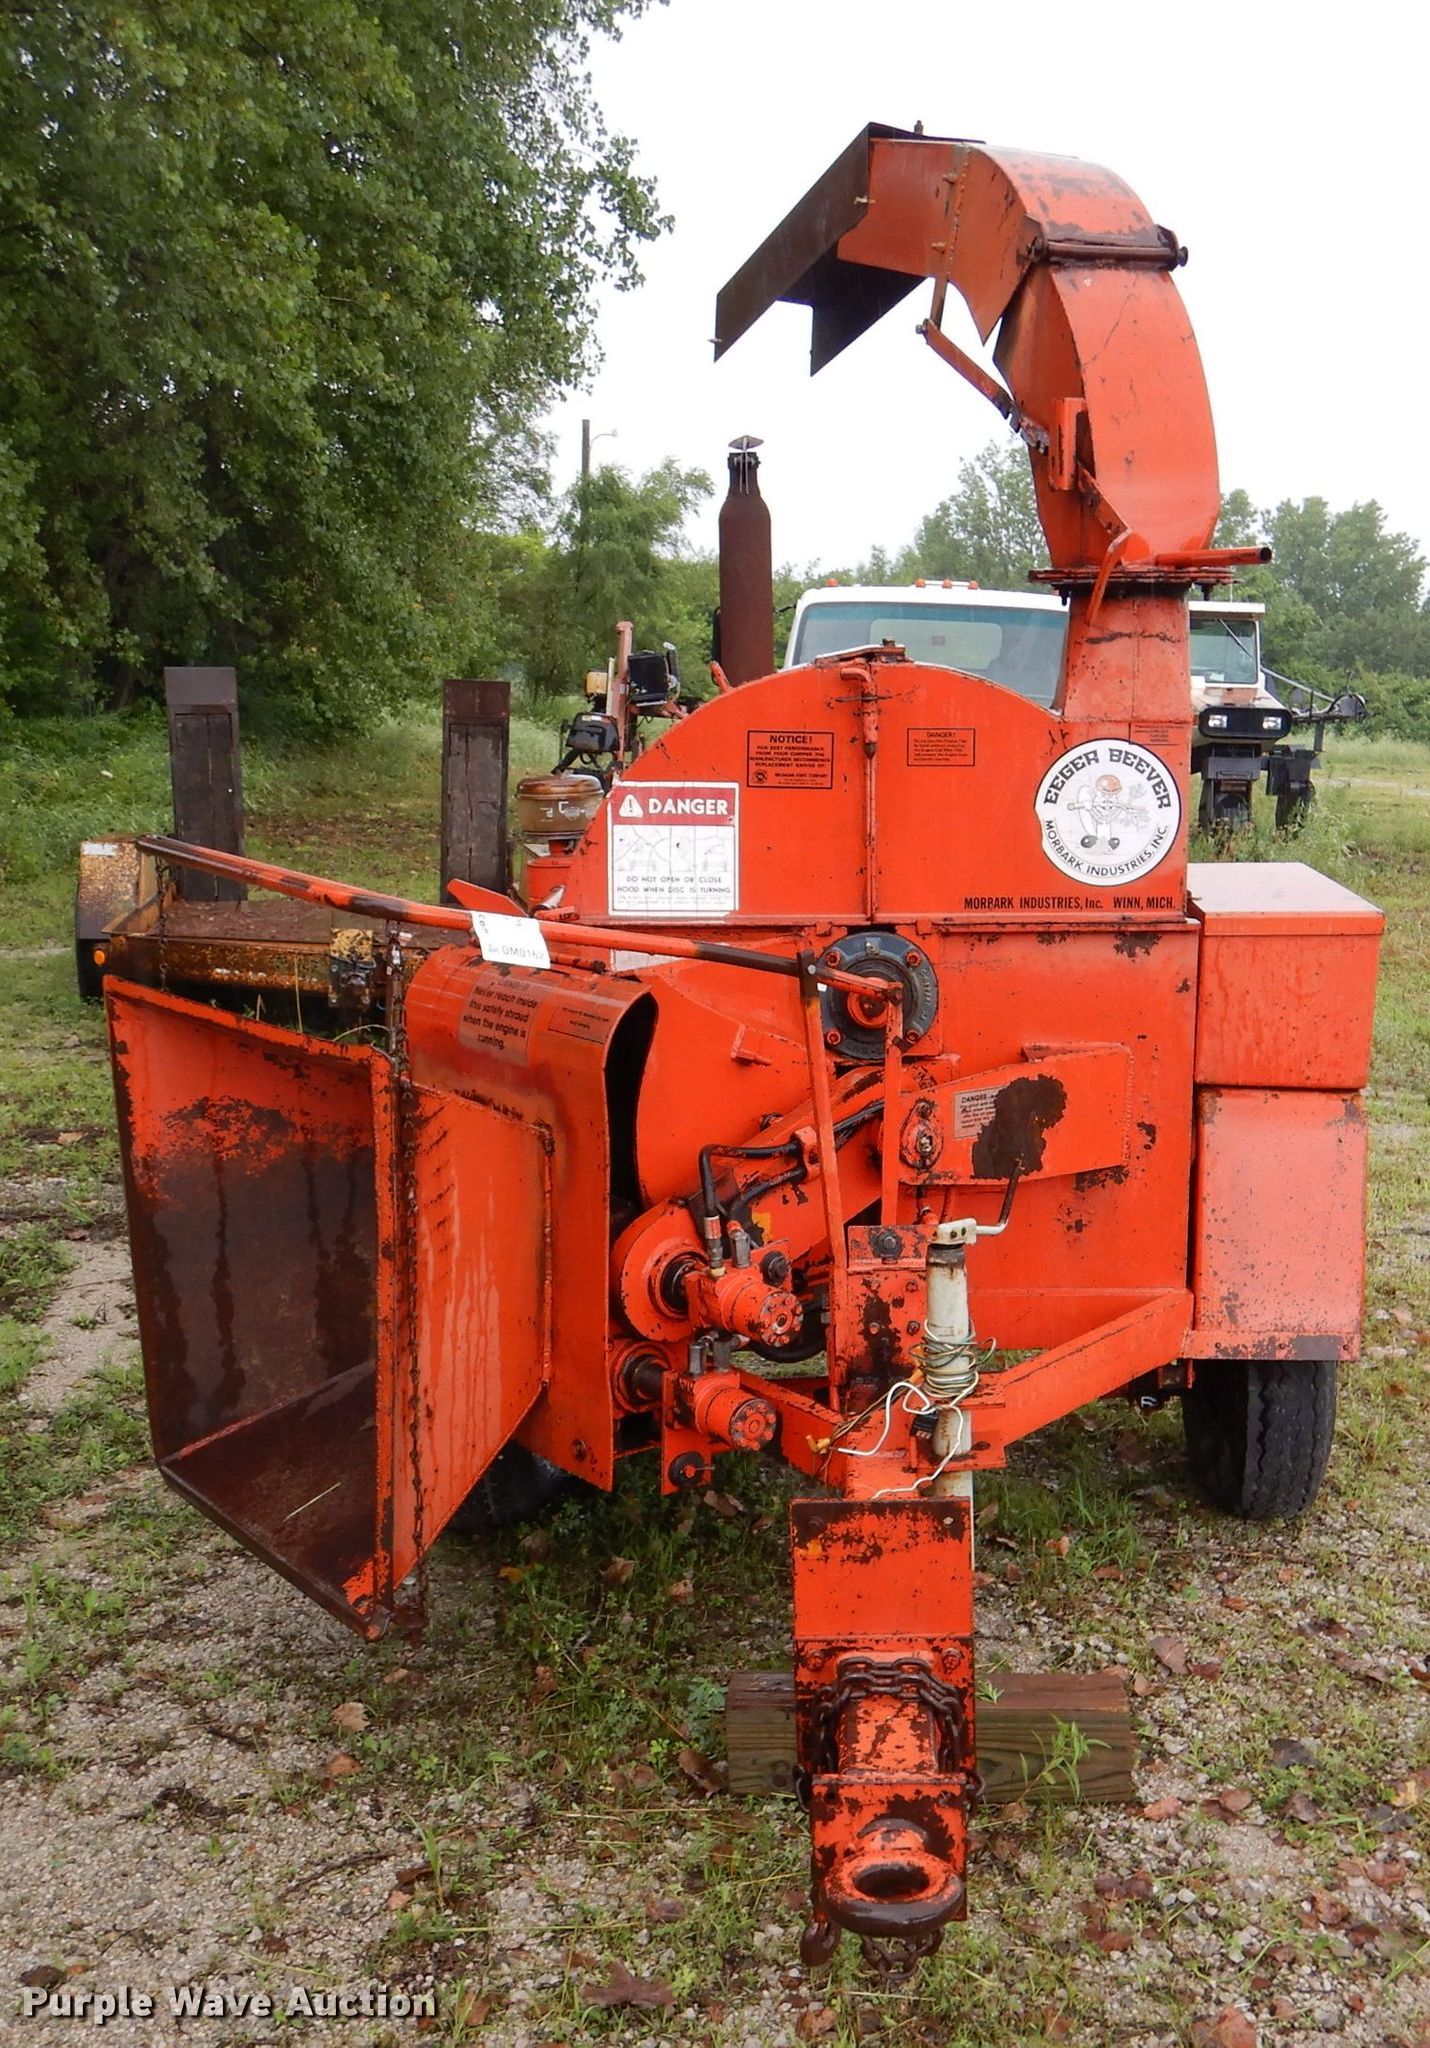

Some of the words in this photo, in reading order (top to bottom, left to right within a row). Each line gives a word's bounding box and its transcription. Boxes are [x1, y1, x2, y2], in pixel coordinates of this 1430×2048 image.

[770, 735, 812, 744] NOTICE!
[1044, 750, 1100, 804] EEGER
[1108, 748, 1171, 809] BEEVER
[648, 798, 728, 815] DANGER
[1045, 820, 1082, 870] MORBARK
[1150, 825, 1168, 850] INC.
[964, 896, 1014, 909] MORBARK
[1020, 896, 1083, 910] INDUSTRIES,
[1085, 897, 1103, 909] Inc.
[1113, 896, 1143, 910] WINN,
[1146, 896, 1176, 909] MICH.
[474, 986, 495, 998] Never
[494, 992, 516, 1002] reach
[516, 994, 538, 1008] inside
[469, 1000, 482, 1010] this
[482, 1004, 504, 1016] safety
[504, 1009, 529, 1023] shroud
[463, 1014, 481, 1026] when
[482, 1017, 494, 1030] the
[495, 1023, 519, 1036] engine
[520, 1026, 526, 1038] is
